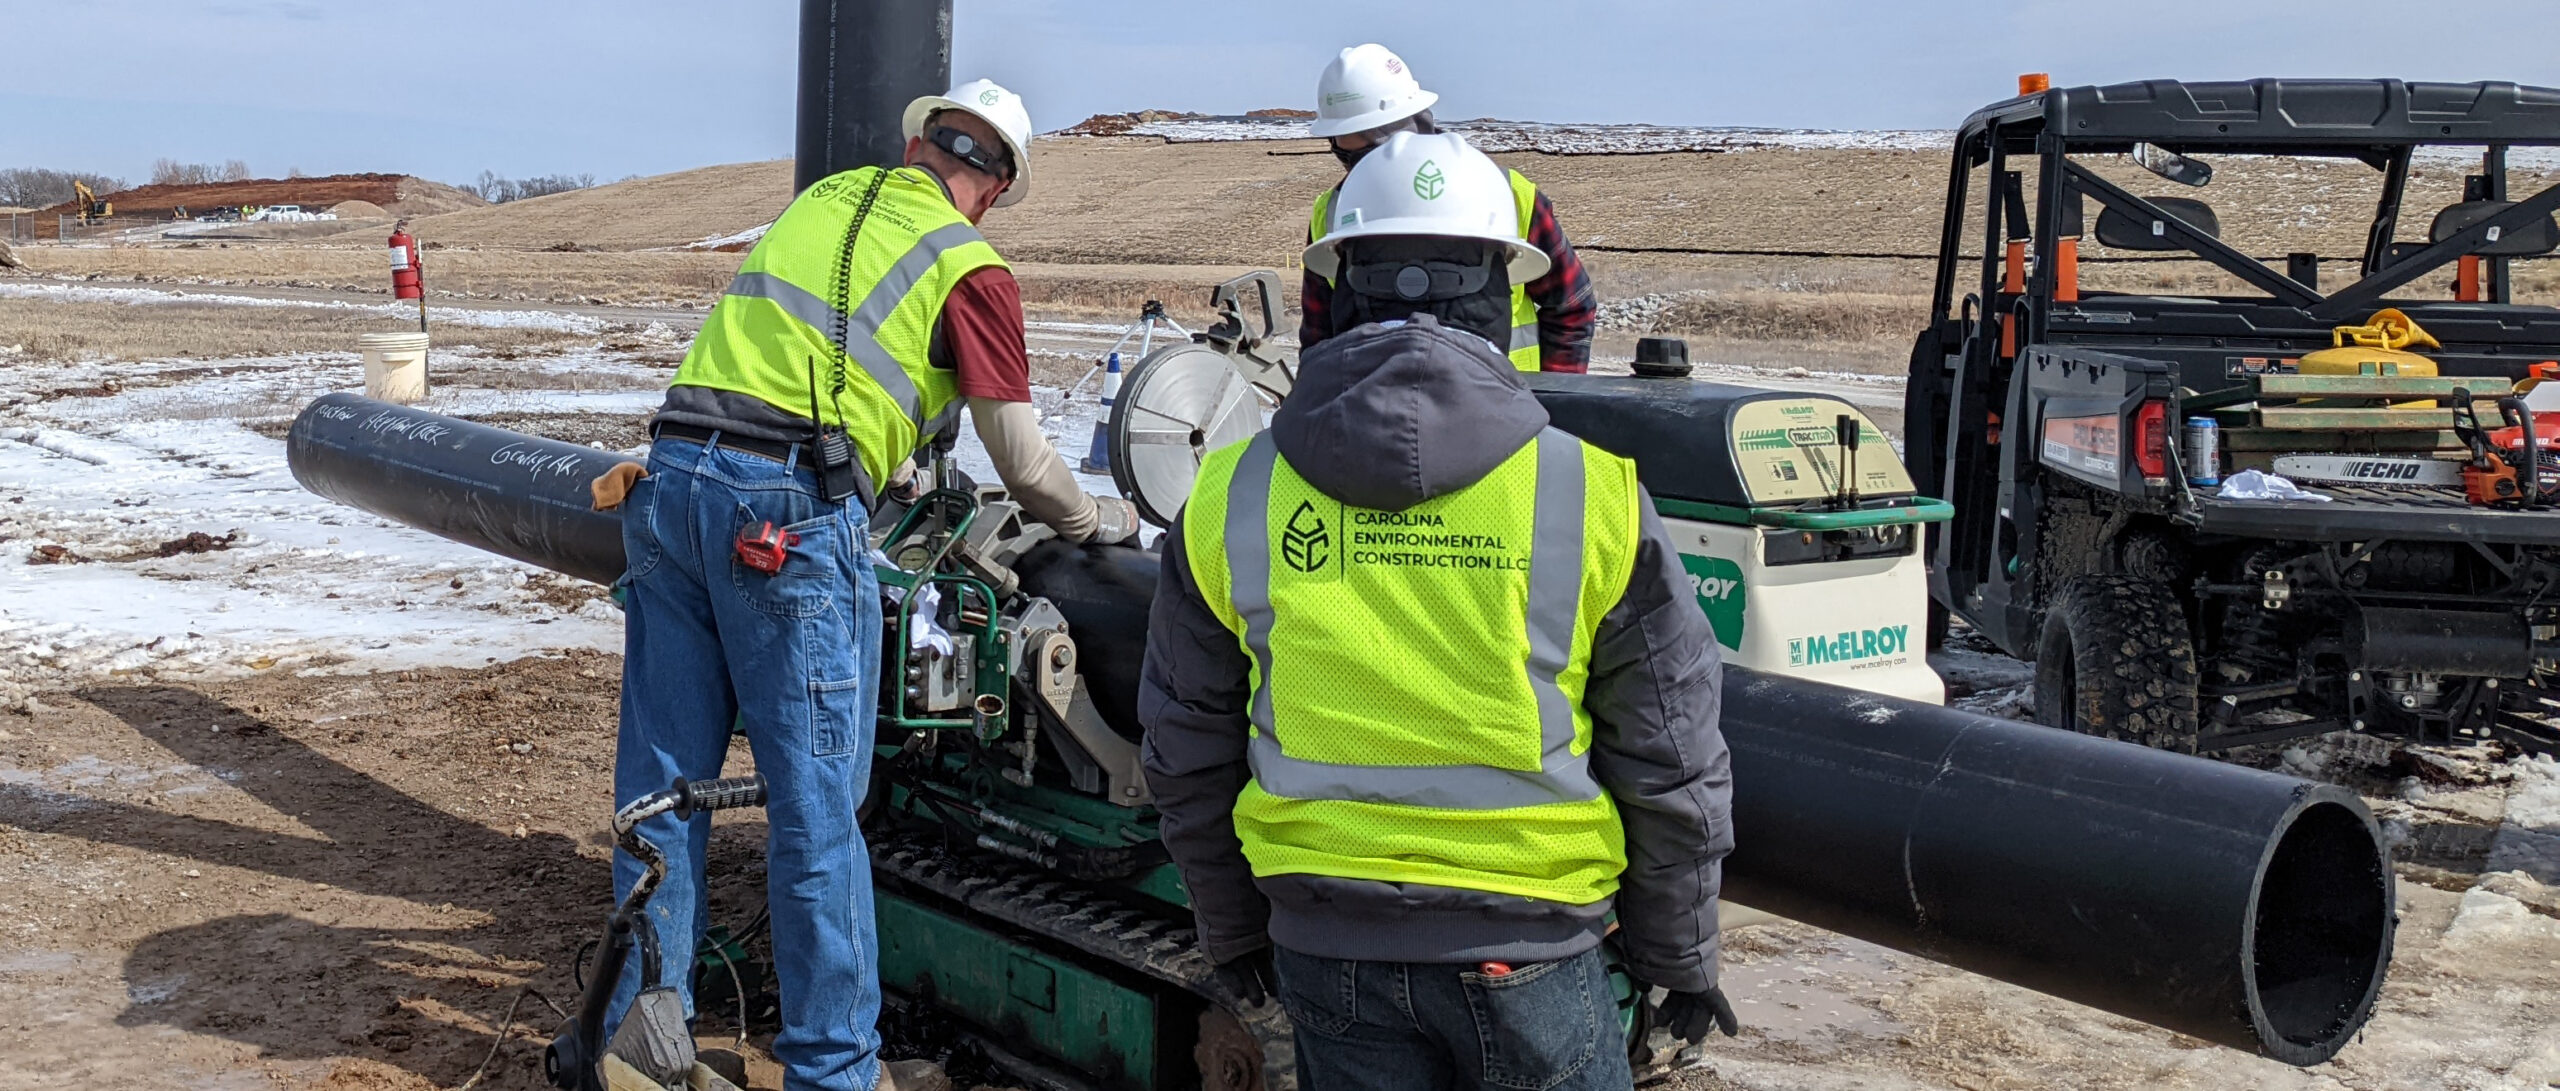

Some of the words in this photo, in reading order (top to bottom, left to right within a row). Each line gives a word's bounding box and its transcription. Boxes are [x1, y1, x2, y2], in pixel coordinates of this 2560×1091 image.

[2357, 461, 2421, 480] ECHO
[1354, 512, 1445, 527] CAROLINA
[1354, 531, 1506, 549] ENVIRONMENTAL
[1353, 551, 1491, 569] CONSTRUCTION
[1496, 555, 1528, 571] LLC
